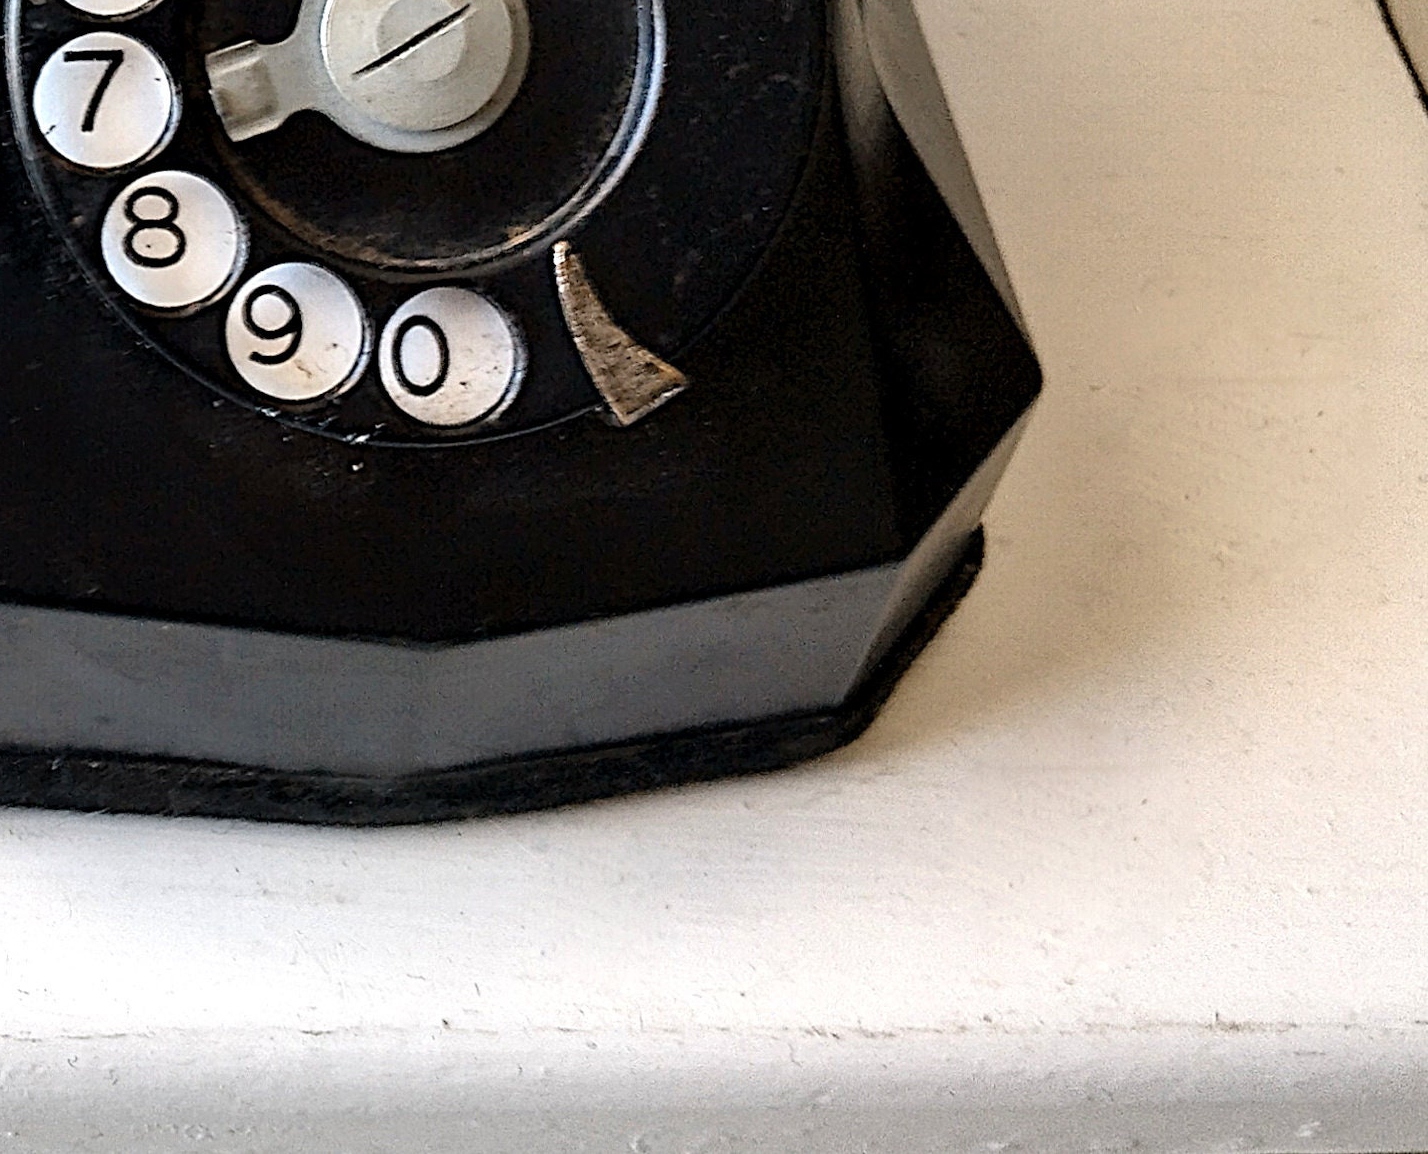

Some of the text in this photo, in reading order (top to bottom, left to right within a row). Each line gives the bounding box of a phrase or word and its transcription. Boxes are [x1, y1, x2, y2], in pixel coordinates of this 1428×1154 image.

[64, 50, 124, 132] 7
[123, 186, 186, 268] 8
[243, 285, 303, 365] 9
[392, 315, 450, 397] 0
